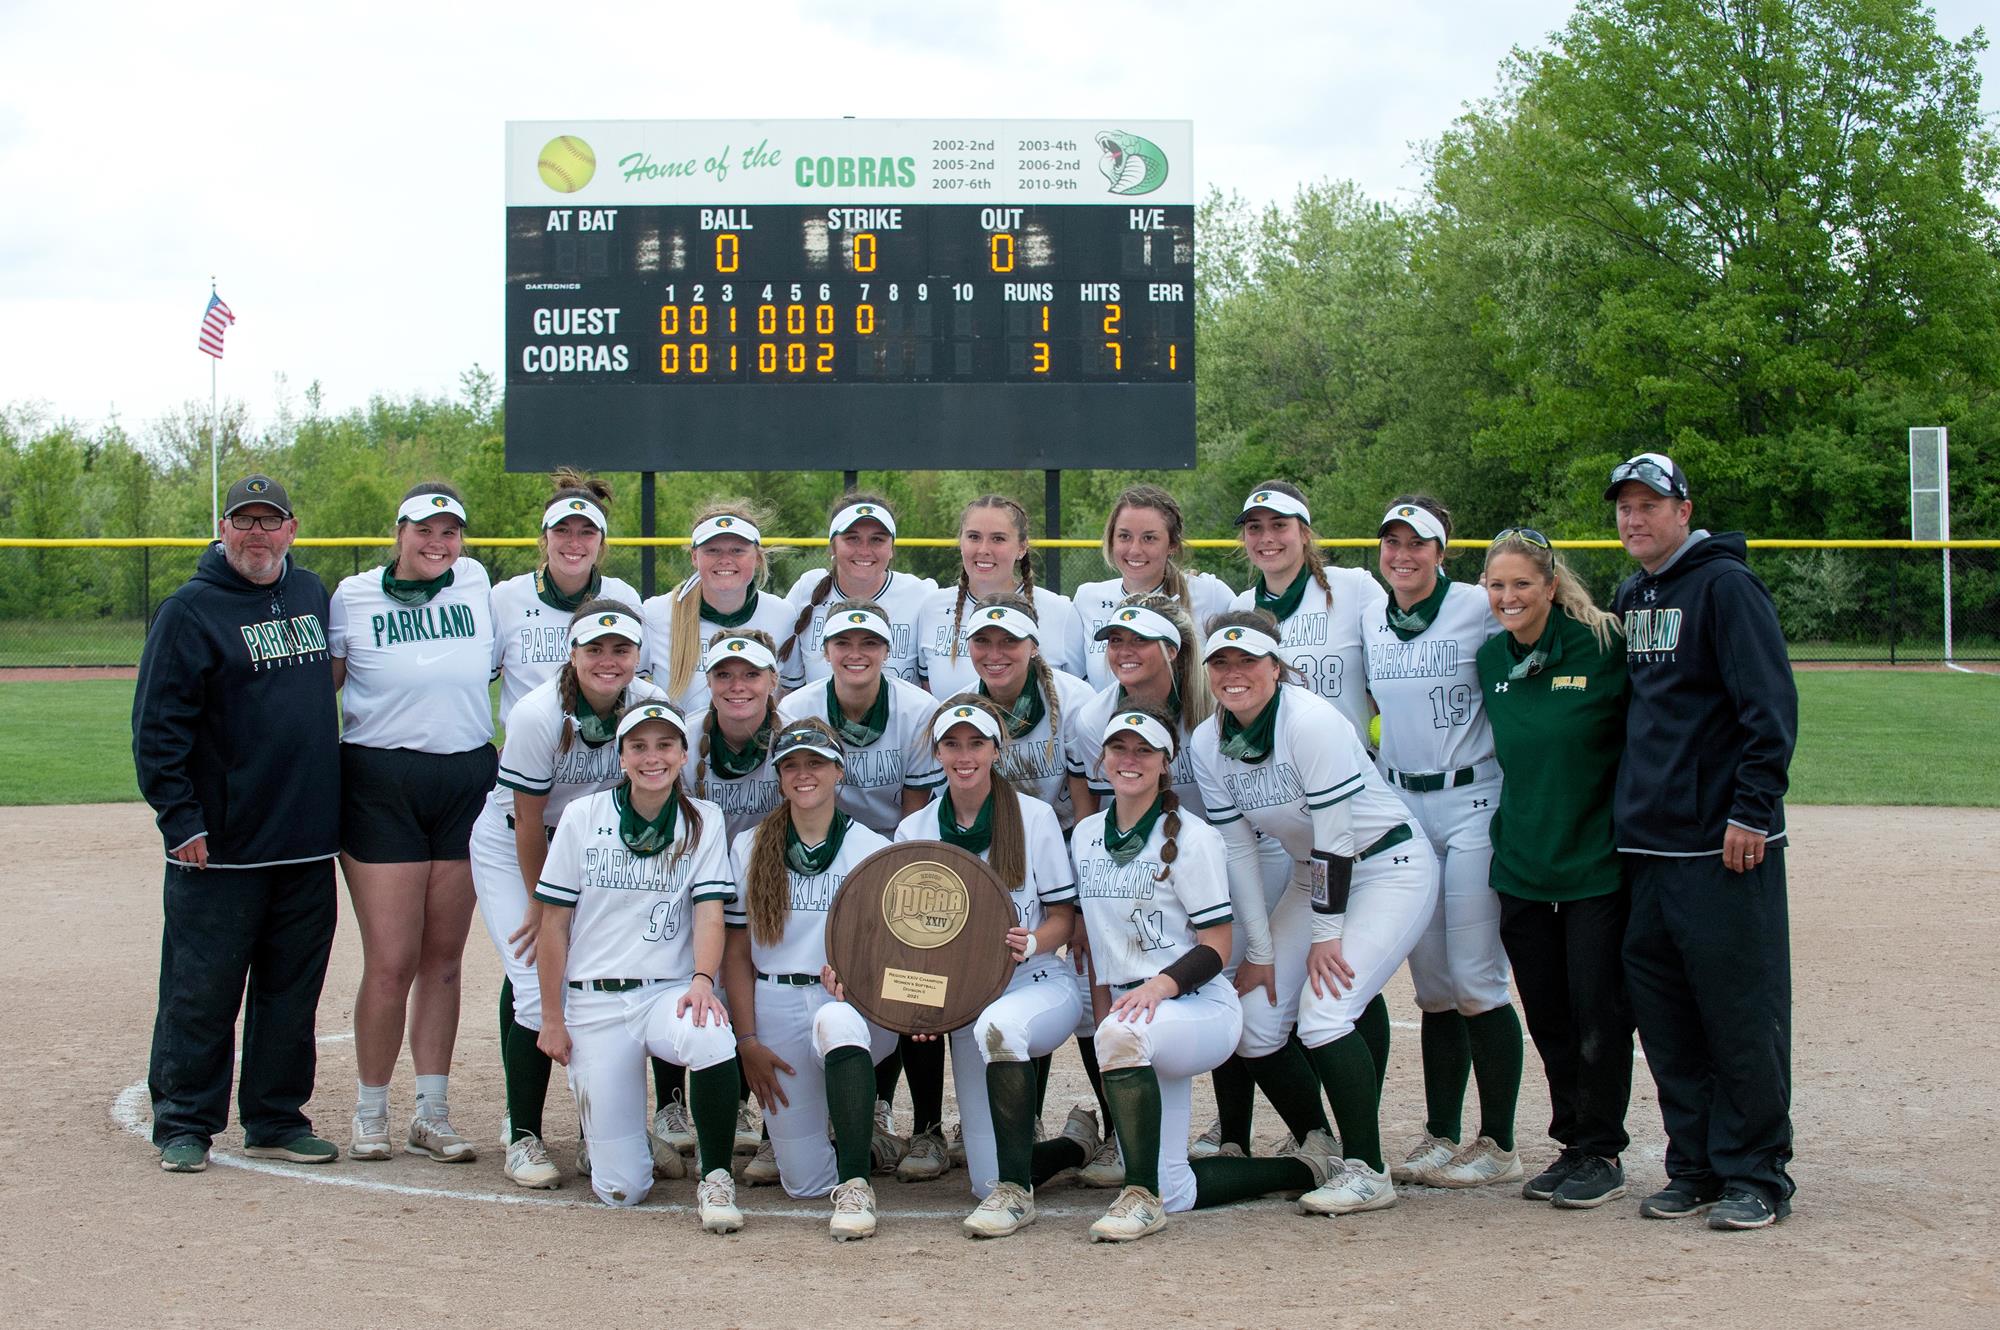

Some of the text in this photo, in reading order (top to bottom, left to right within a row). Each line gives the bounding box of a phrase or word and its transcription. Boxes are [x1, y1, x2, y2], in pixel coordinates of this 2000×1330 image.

[932, 139, 995, 151] 2002-2nd
[1018, 139, 1077, 151] 2003-4th
[618, 138, 916, 188] Home of the COBRAS
[932, 159, 995, 171] 2005-2nd
[1018, 159, 1081, 171] 2006-2nd
[932, 178, 991, 190] 2007-6th
[1018, 178, 1077, 190] 2010-9th
[546, 209, 618, 231] AT BAT
[700, 208, 753, 230] BALL
[827, 208, 902, 230] STRIKE
[980, 208, 1024, 230] OUT
[1129, 208, 1165, 230] H/E
[716, 233, 739, 273] 0
[854, 233, 877, 273] 0
[991, 233, 1014, 273] 0
[666, 284, 974, 302] 1 2 3 4 5 6 7 8 9 10
[1004, 283, 1053, 301] RUNS
[1080, 283, 1120, 301] HITS
[1149, 283, 1184, 301] ERR
[533, 308, 620, 335] GUEST
[661, 305, 1121, 334] 0 0 1 0 0 0 0 1 2
[523, 344, 629, 373] COBRAS
[661, 343, 1176, 373] 0 0 1 0 0 2 3 7 1
[240, 614, 327, 662] PARKLAND
[371, 603, 476, 649] PARKLAND
[1279, 611, 1329, 649] LAND
[520, 627, 571, 664] PARK
[1371, 639, 1459, 680] PARKLAND
[1292, 654, 1344, 698] 38
[1428, 684, 1472, 729] 19
[552, 747, 623, 785] PARKLA
[1223, 762, 1306, 812] PARKLAND
[585, 847, 693, 893] PARKLAND
[1079, 858, 1160, 901] PARKLAND
[892, 884, 963, 919] NJCAA
[925, 915, 948, 928] XXIV
[1130, 908, 1176, 952] 11
